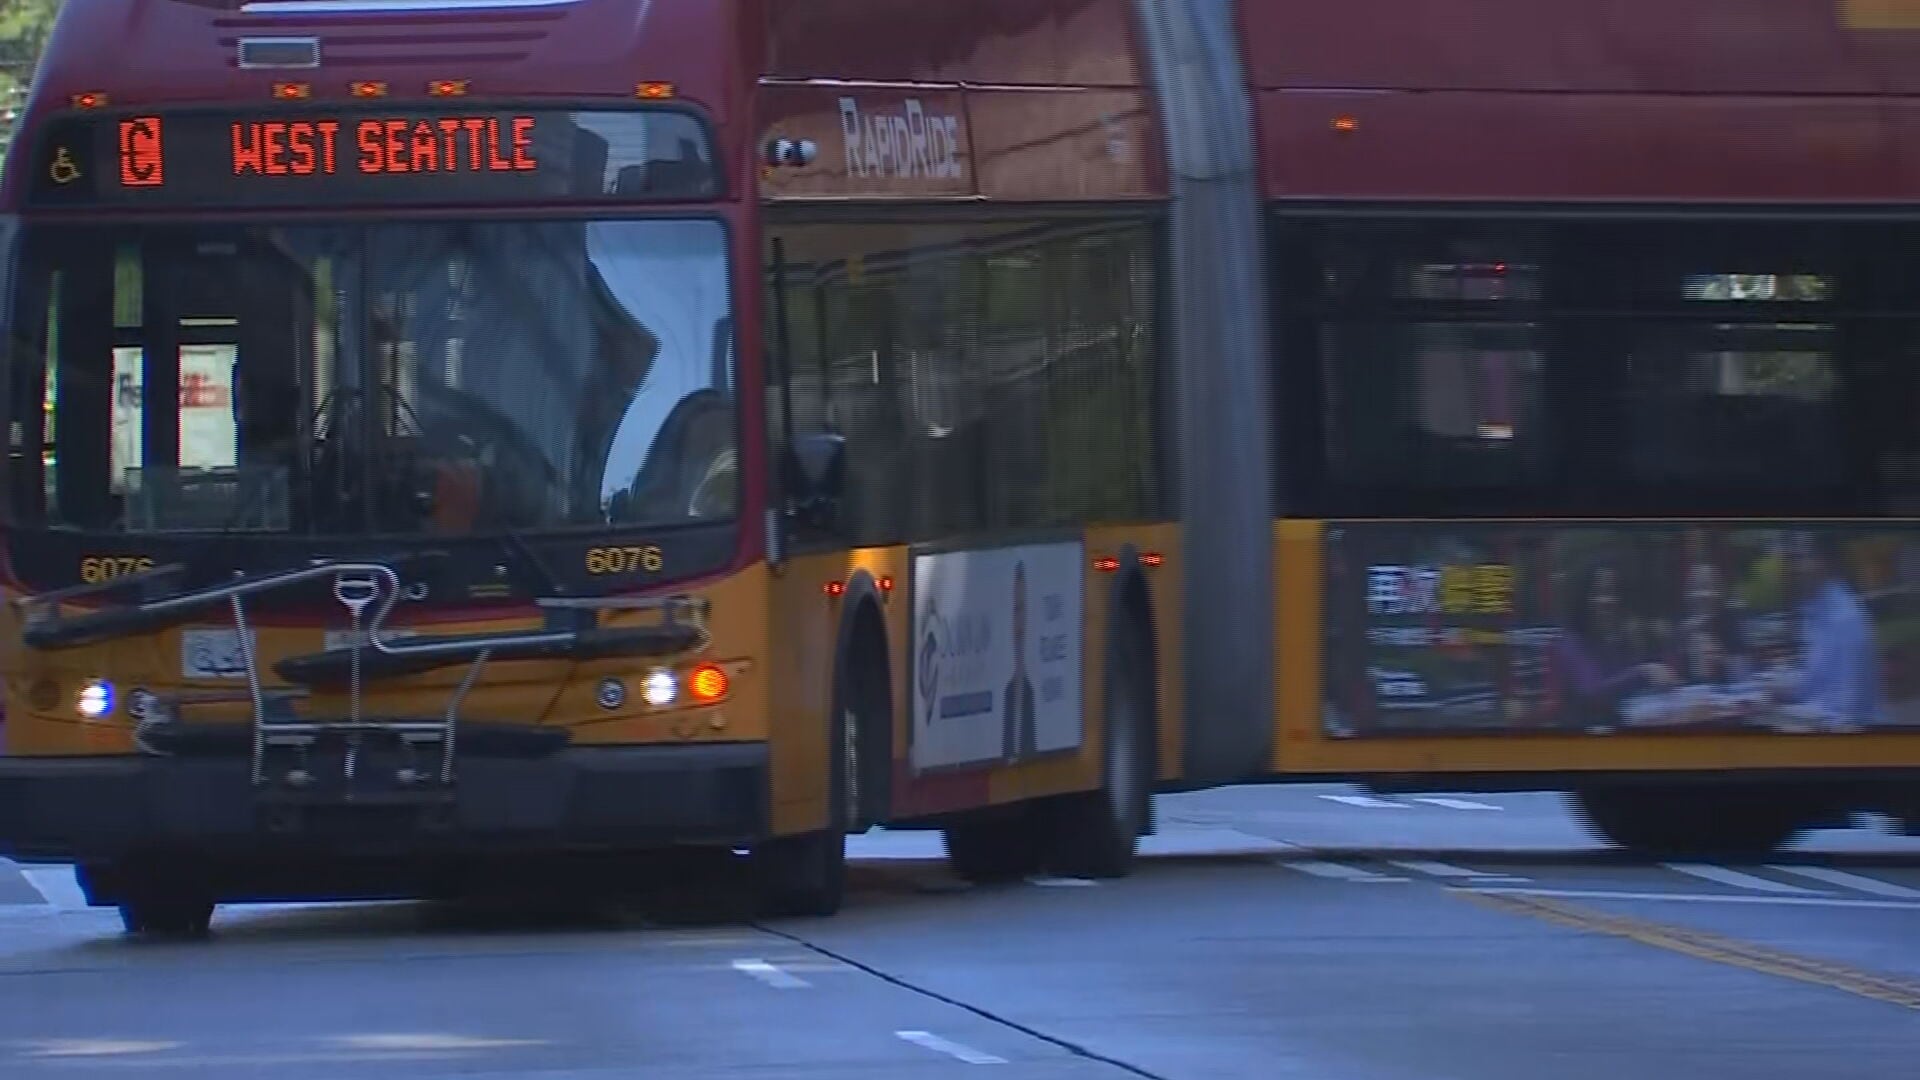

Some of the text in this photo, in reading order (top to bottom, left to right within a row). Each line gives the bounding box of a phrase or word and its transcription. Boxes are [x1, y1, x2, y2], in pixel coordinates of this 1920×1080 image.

[121, 117, 537, 184] C WEST SEATTLE
[586, 546, 663, 573] 6076
